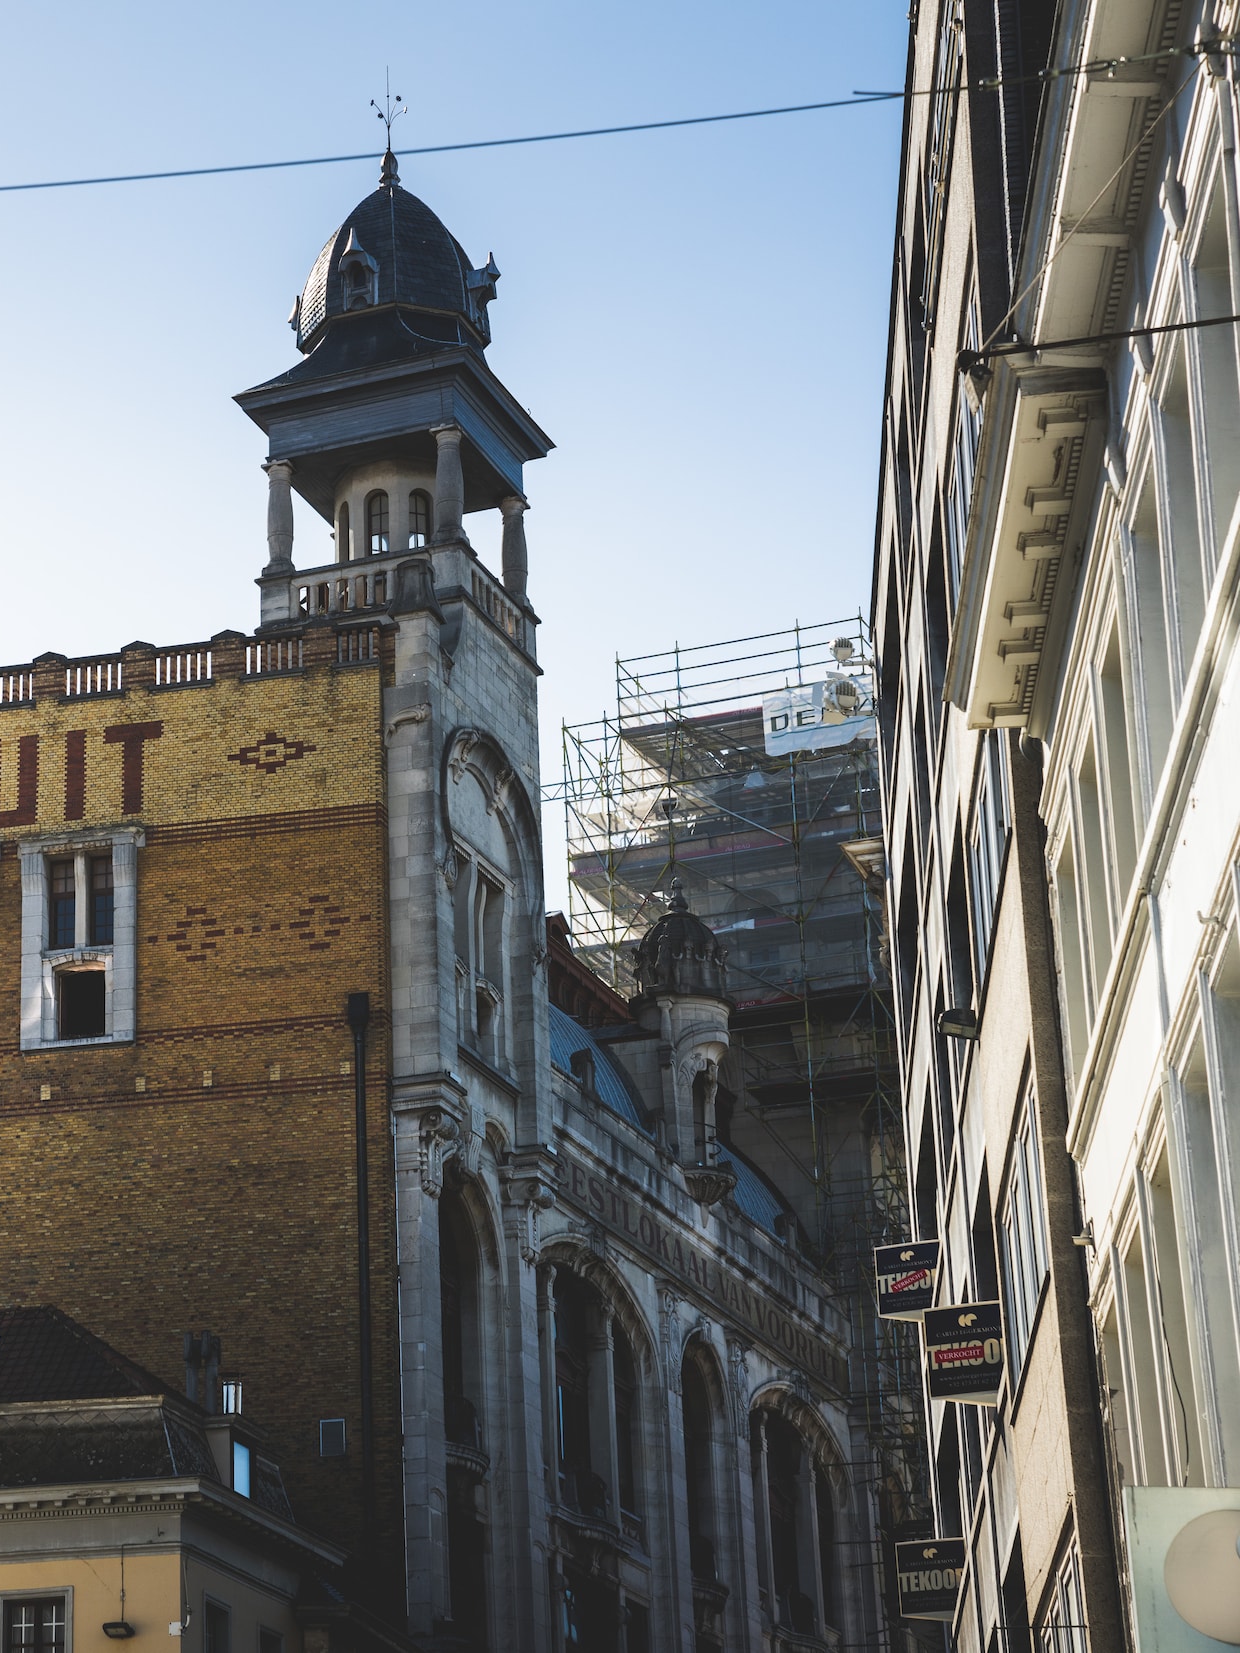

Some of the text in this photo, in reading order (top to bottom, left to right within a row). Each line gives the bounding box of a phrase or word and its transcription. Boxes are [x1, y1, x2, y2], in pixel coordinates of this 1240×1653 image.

[893, 1272, 924, 1290] VERKOCHT
[717, 1271, 751, 1320] VAN
[753, 1296, 839, 1382] VOORUIT
[927, 1337, 1003, 1370] TEKOO
[938, 1349, 981, 1360] VERKOCHT
